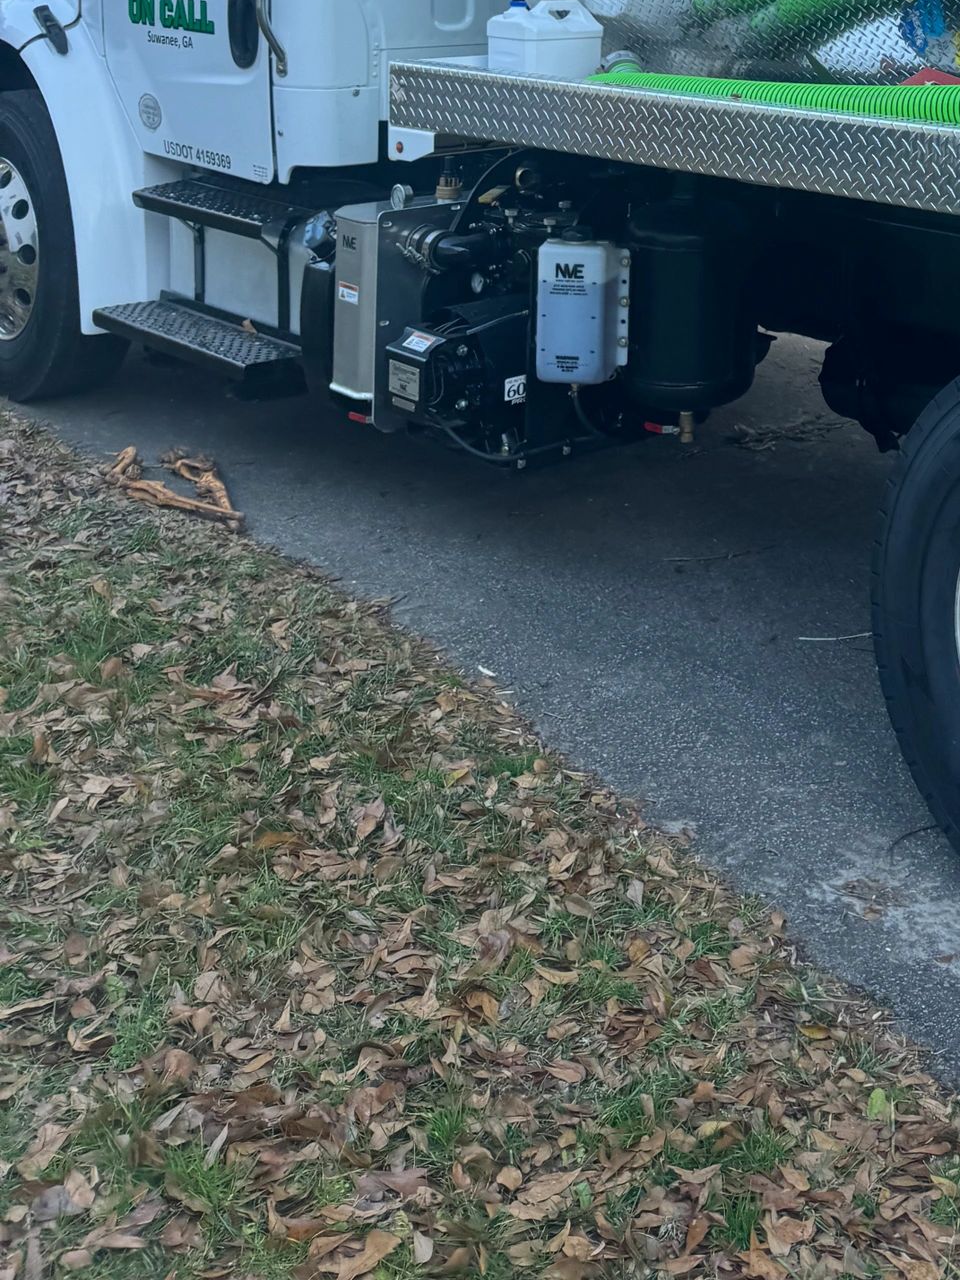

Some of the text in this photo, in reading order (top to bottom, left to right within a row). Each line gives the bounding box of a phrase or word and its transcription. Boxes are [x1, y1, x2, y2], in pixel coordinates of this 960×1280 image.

[147, 30, 194, 49] Suwanee, GA
[163, 139, 232, 170] USDOT 4159369
